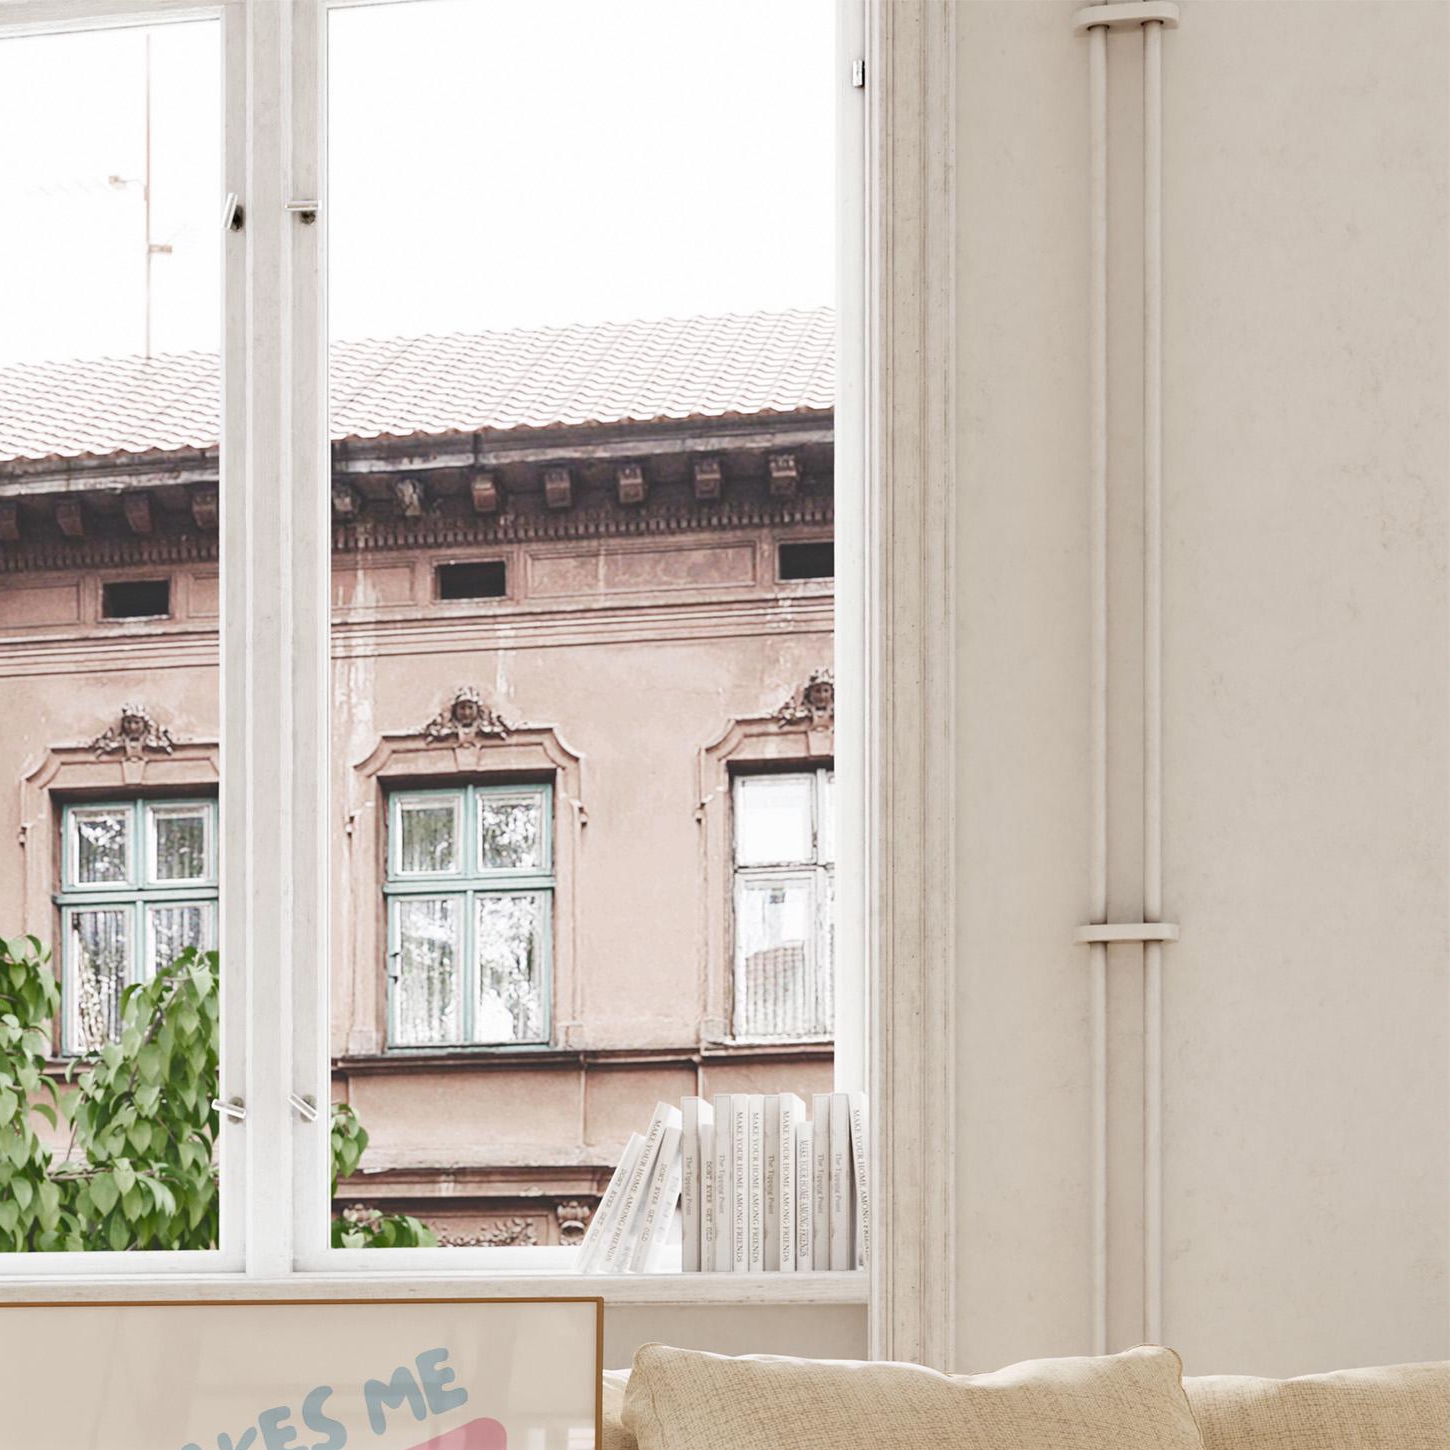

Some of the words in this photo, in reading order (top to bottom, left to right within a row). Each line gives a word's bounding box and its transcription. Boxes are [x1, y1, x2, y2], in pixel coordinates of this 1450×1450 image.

[648, 1119, 662, 1142] MAKE
[735, 1111, 743, 1135] MAKE
[751, 1111, 759, 1136] MAKE
[782, 1110, 790, 1134] MAKE
[853, 1109, 861, 1132] MAKE
[639, 1142, 653, 1168] YOUR
[735, 1137, 743, 1162] YOUR
[751, 1138, 759, 1161] YOUR
[782, 1136, 790, 1160] YOUR
[855, 1134, 863, 1160] YOUR
[630, 1168, 644, 1194] HOME
[735, 1163, 743, 1188] HOME
[751, 1163, 759, 1188] HOME
[782, 1162, 790, 1188] HOME
[857, 1161, 867, 1188] HOME
[618, 1193, 634, 1227] AMONG
[645, 1209, 655, 1224] GET
[735, 1191, 743, 1224] AMONG
[751, 1192, 759, 1224] AMONG
[782, 1191, 790, 1223] AMONG
[860, 1190, 870, 1222] AMONG
[606, 1226, 623, 1262] FRIENDS
[735, 1226, 743, 1262] FRIENDS
[751, 1226, 759, 1263] FRIENDS
[782, 1225, 790, 1262] FRIENDS
[364, 1348, 468, 1434] ME
